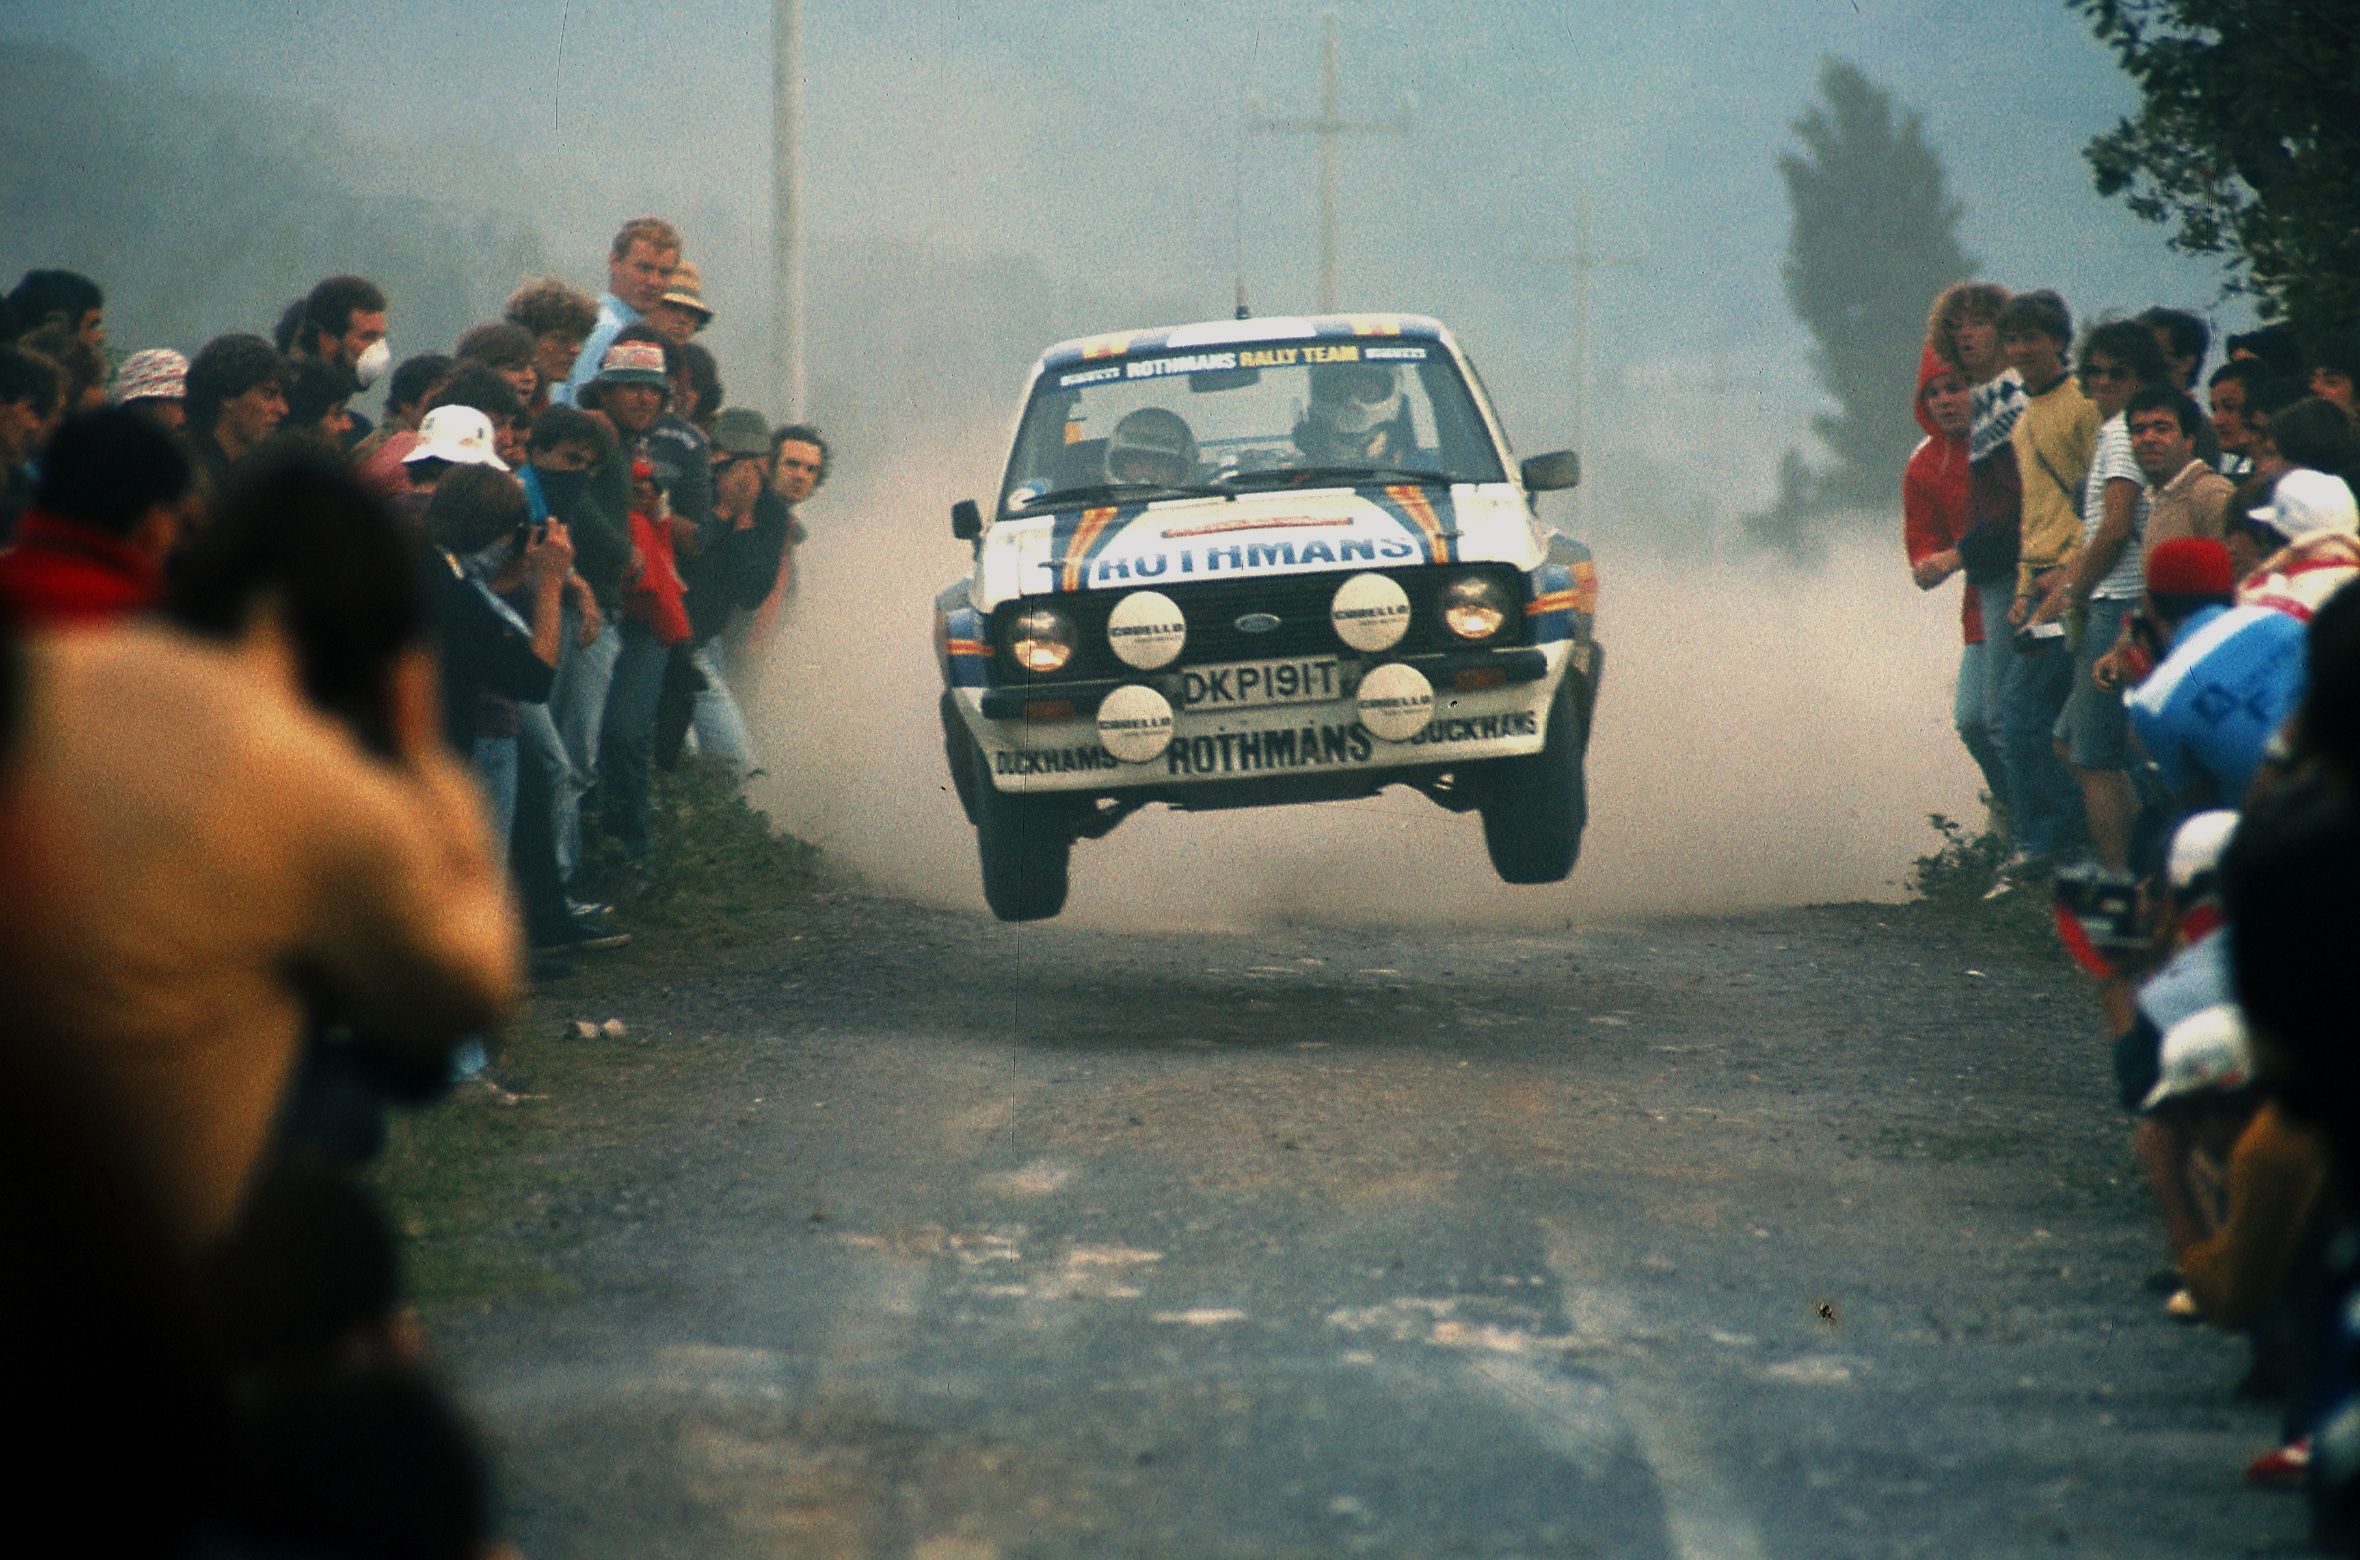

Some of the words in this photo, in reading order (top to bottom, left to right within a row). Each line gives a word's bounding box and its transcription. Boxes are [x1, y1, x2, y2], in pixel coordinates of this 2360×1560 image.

[1239, 349, 1297, 367] RALLY
[1302, 345, 1360, 363] TEAM
[1097, 537, 1414, 581] ROTHMANS
[1168, 722, 1372, 775] ROTHMANS
